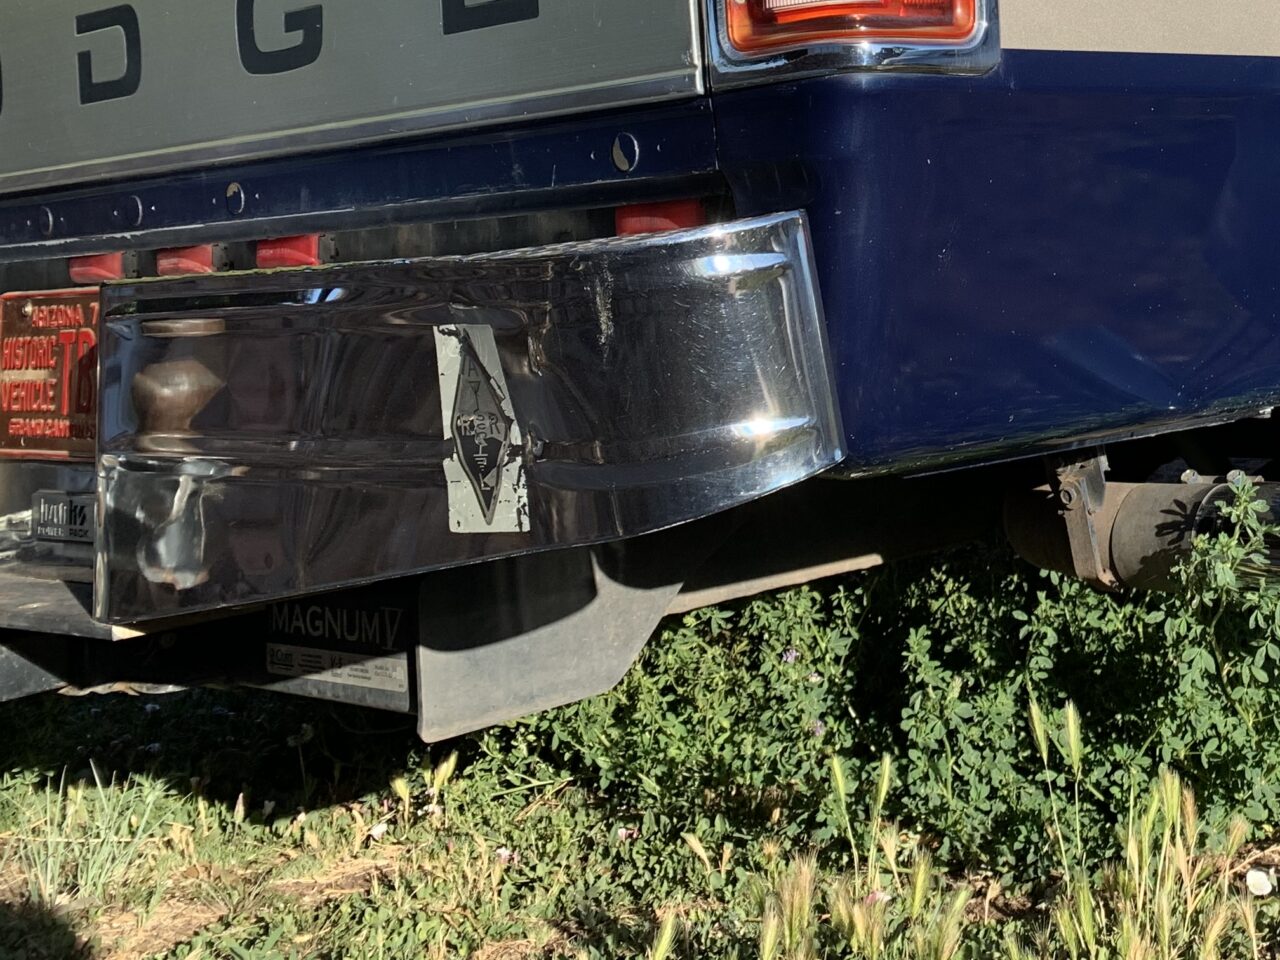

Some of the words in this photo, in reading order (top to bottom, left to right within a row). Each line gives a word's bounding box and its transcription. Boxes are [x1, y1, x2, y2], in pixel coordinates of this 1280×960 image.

[31, 303, 84, 327] ARIZONA
[2, 335, 57, 370] HISTORIC
[1, 378, 57, 413] VEHICLE
[271, 602, 381, 645] MAGNUM
